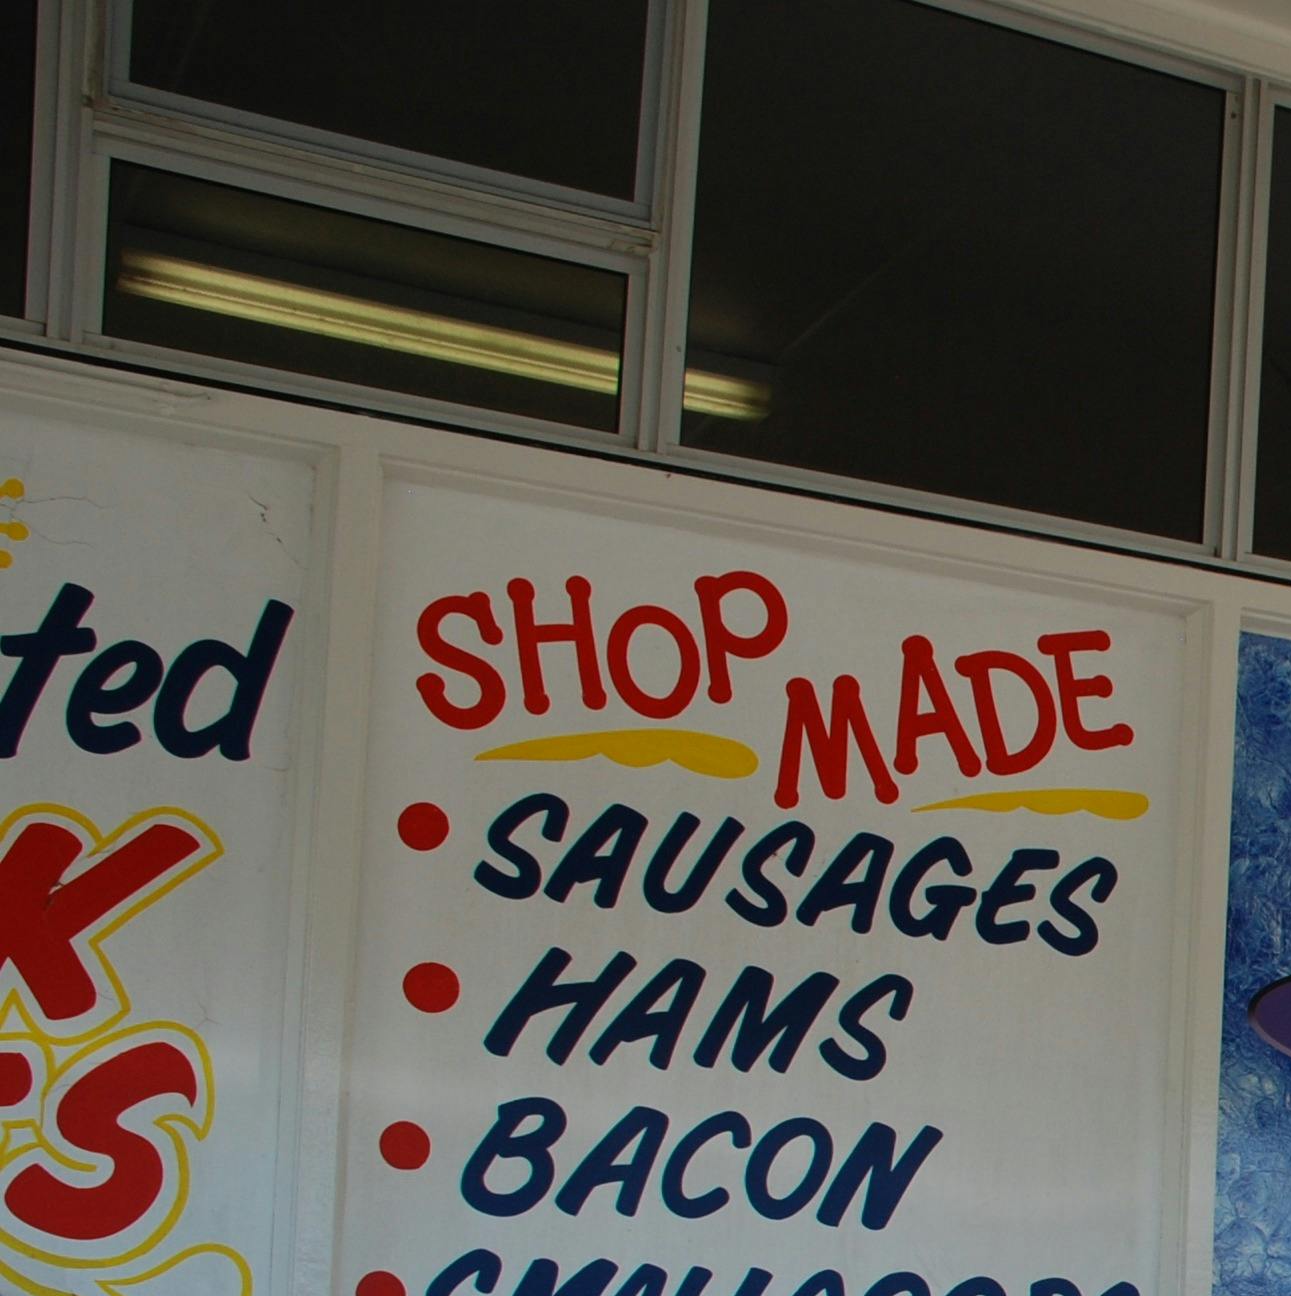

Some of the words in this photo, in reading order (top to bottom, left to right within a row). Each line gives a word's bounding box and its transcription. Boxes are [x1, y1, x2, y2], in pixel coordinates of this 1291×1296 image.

[0, 582, 295, 761] ted
[416, 570, 788, 729] SHOP
[774, 628, 1134, 808] MADE
[474, 793, 1118, 956] SAUSAGES
[484, 946, 915, 1082] HAMS
[0, 1041, 197, 1240] S
[459, 1096, 944, 1231] BACON
